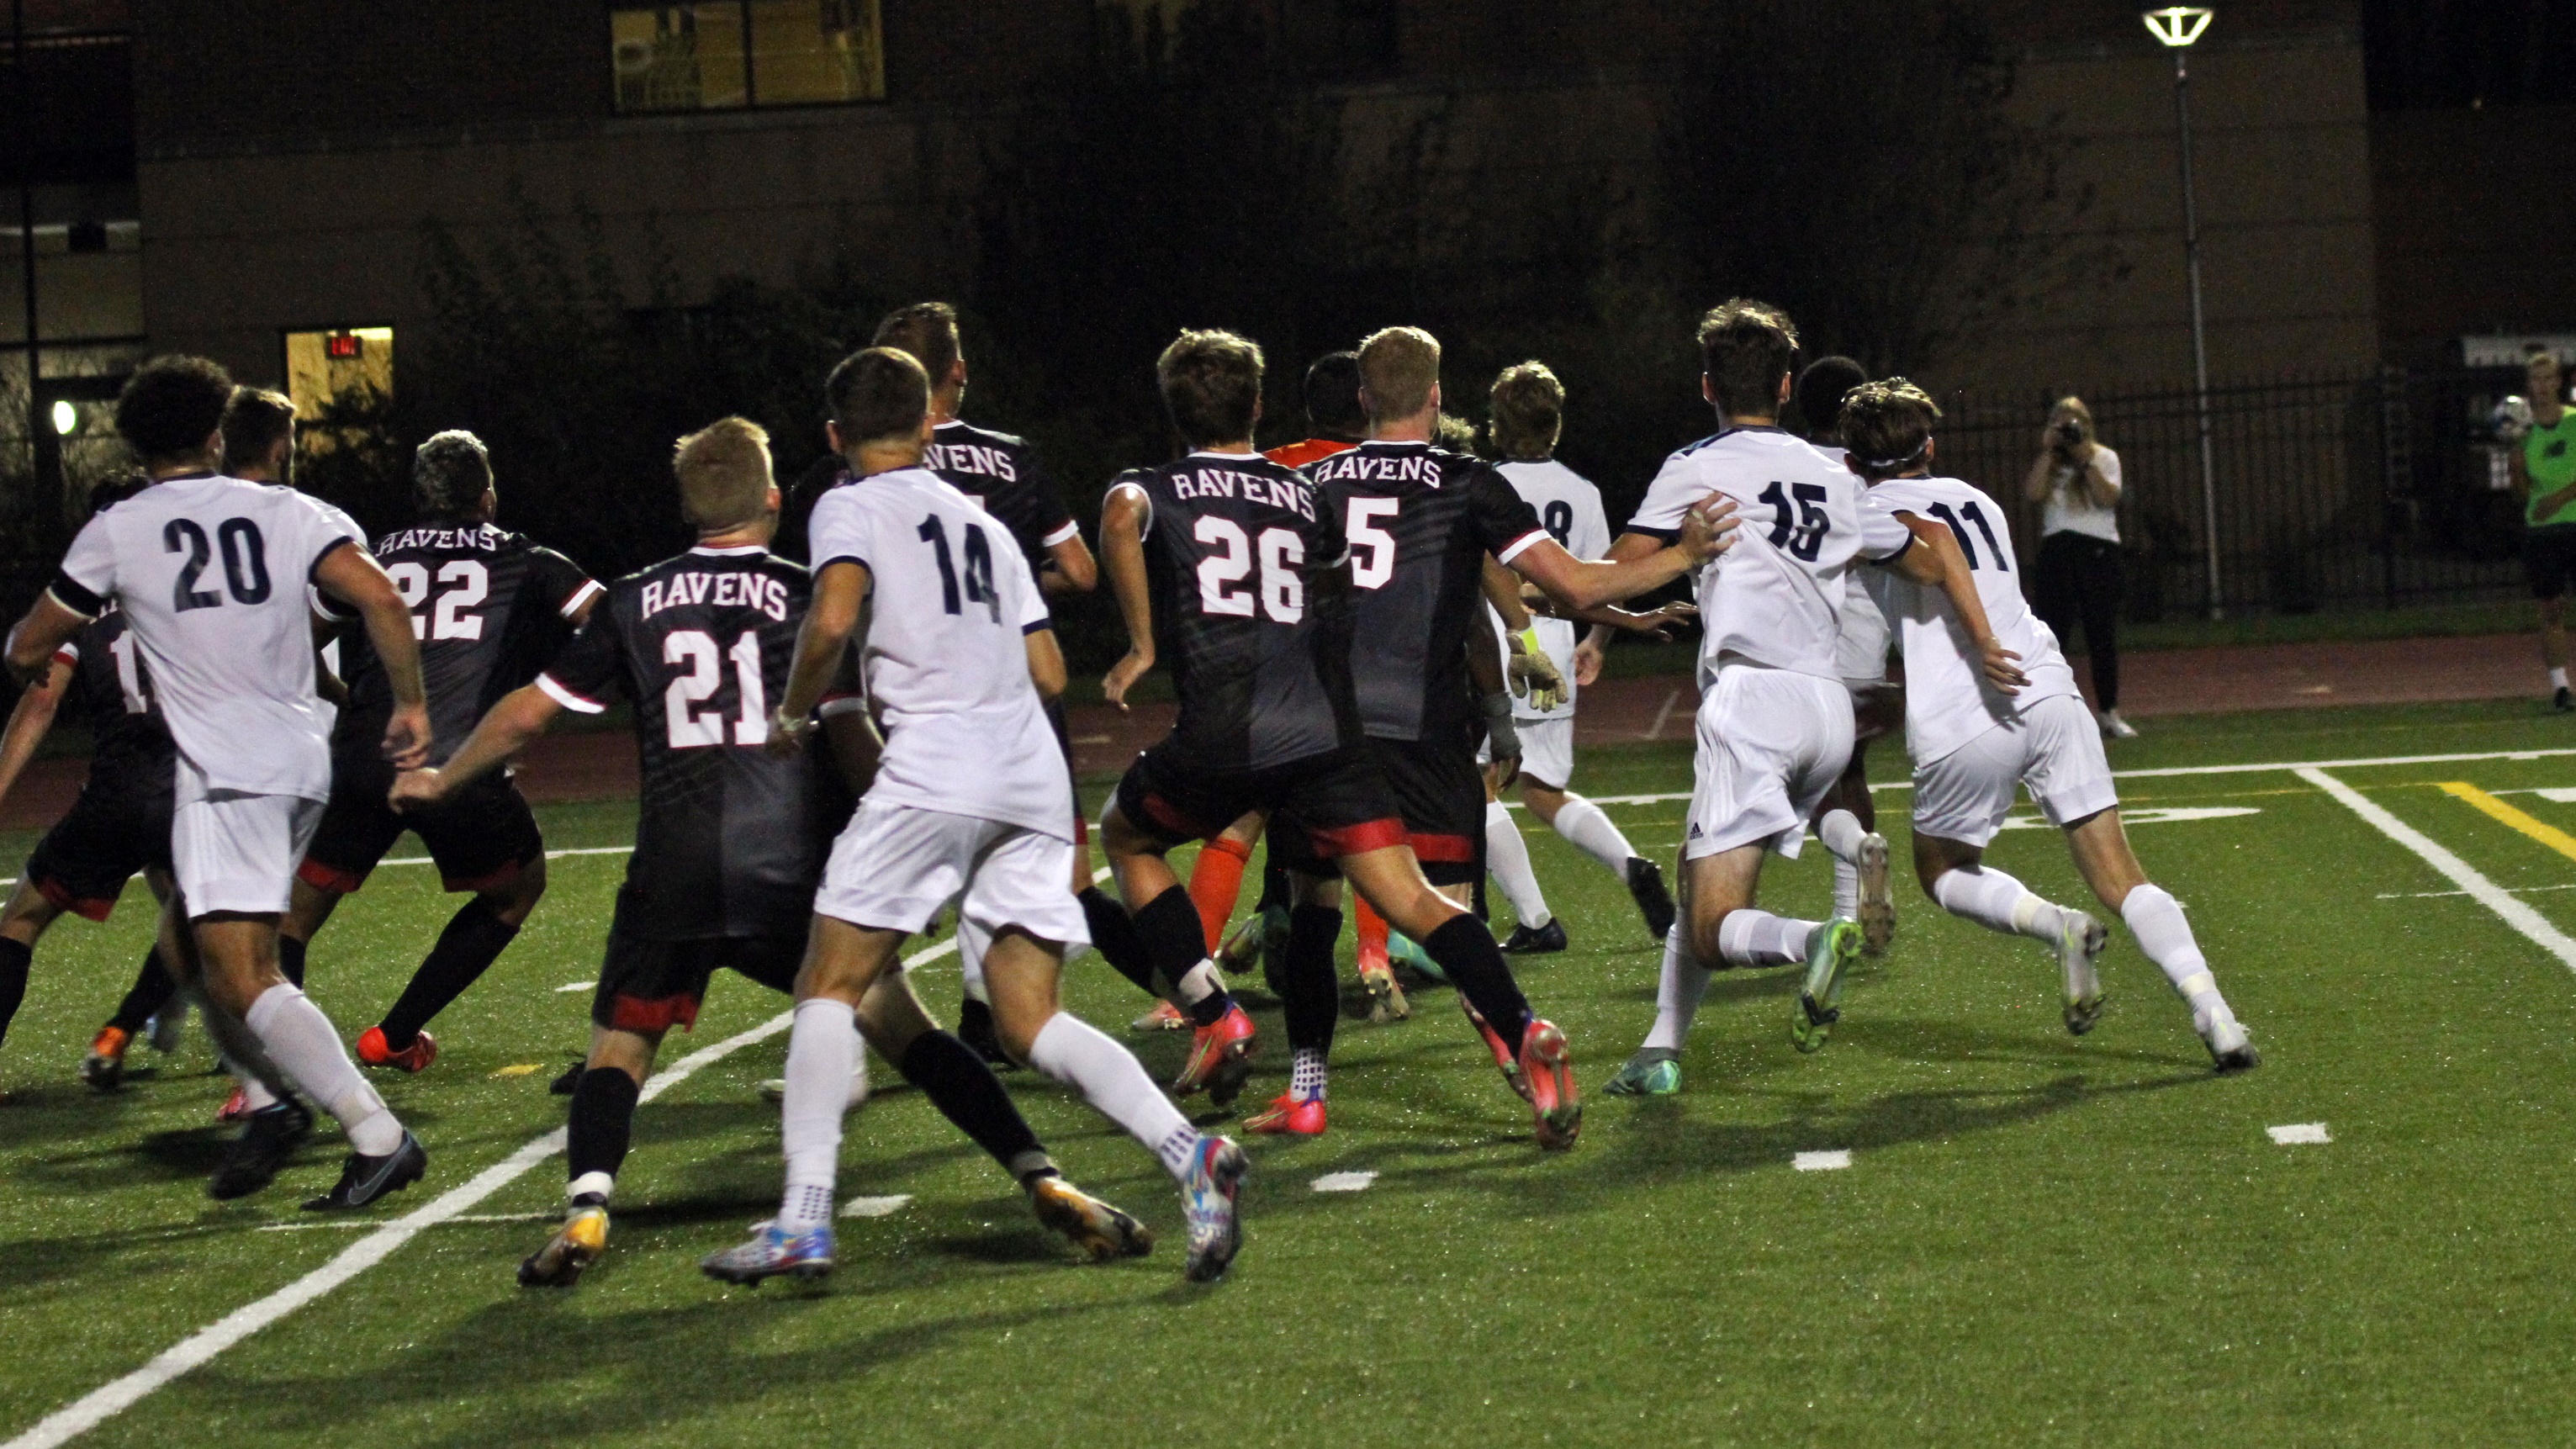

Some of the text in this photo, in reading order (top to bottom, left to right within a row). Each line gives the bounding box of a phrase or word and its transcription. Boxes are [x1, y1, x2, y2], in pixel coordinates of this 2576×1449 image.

[1172, 468, 1316, 523] RAVENS
[1314, 456, 1441, 489] RAVENS
[375, 528, 496, 557] RAVENS
[1346, 497, 1399, 590] 5
[1758, 480, 1831, 563] 15
[1926, 500, 2009, 573] 11
[163, 516, 272, 613] 20
[386, 559, 488, 640] 22
[641, 572, 787, 621] RAVENS
[917, 513, 1002, 627] 14
[1194, 515, 1305, 624] 26
[664, 631, 768, 748] 21
